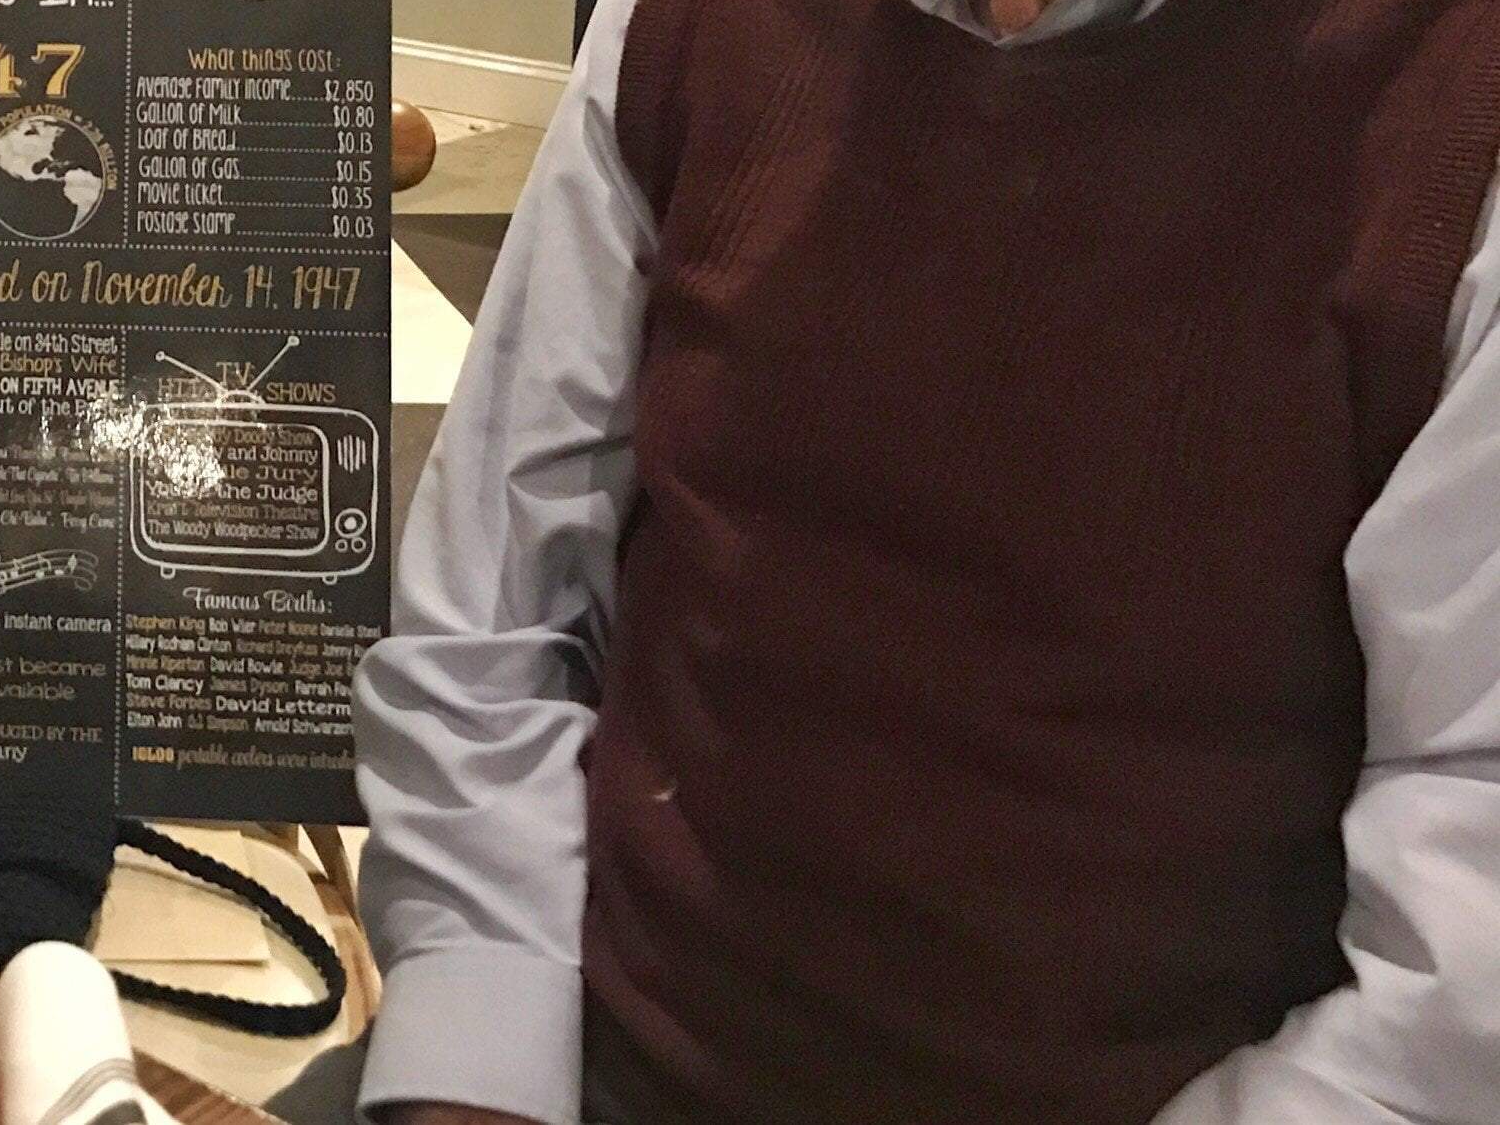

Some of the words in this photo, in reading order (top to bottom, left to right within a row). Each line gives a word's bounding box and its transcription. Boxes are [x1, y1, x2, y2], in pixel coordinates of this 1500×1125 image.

[188, 48, 236, 71] What
[323, 79, 375, 104] $2,850
[135, 101, 185, 125] Gallon
[208, 103, 242, 125] Milk
[333, 104, 375, 128] $0.80
[337, 131, 374, 155] $0.13
[138, 155, 187, 179] Gallon
[336, 159, 373, 183] $0.15
[331, 185, 373, 209] $0.35
[332, 214, 375, 238] $0.03
[31, 271, 71, 304] on
[78, 260, 233, 309] November
[291, 265, 362, 312] 1947
[15, 334, 33, 353] on
[71, 334, 119, 355] Street
[71, 354, 119, 375] Wife
[0, 376, 19, 394] ON
[22, 376, 62, 395] FIFTH
[65, 377, 121, 398] AVENUE
[265, 382, 337, 404] SHOWS
[17, 396, 34, 416] of
[227, 446, 257, 461] and
[260, 446, 319, 466] Johnny
[255, 466, 319, 485] Jury
[217, 483, 252, 501] the
[255, 484, 319, 505] Judge
[182, 586, 261, 611] Famous
[3, 611, 53, 631] instant
[56, 616, 112, 633] camera
[18, 656, 107, 677] became
[210, 655, 245, 674] David
[125, 672, 152, 690] Tom
[155, 674, 205, 696] Clancy
[214, 694, 270, 714] David
[275, 697, 351, 716] Letterm
[46, 725, 67, 741] BY
[70, 726, 103, 744] THE
